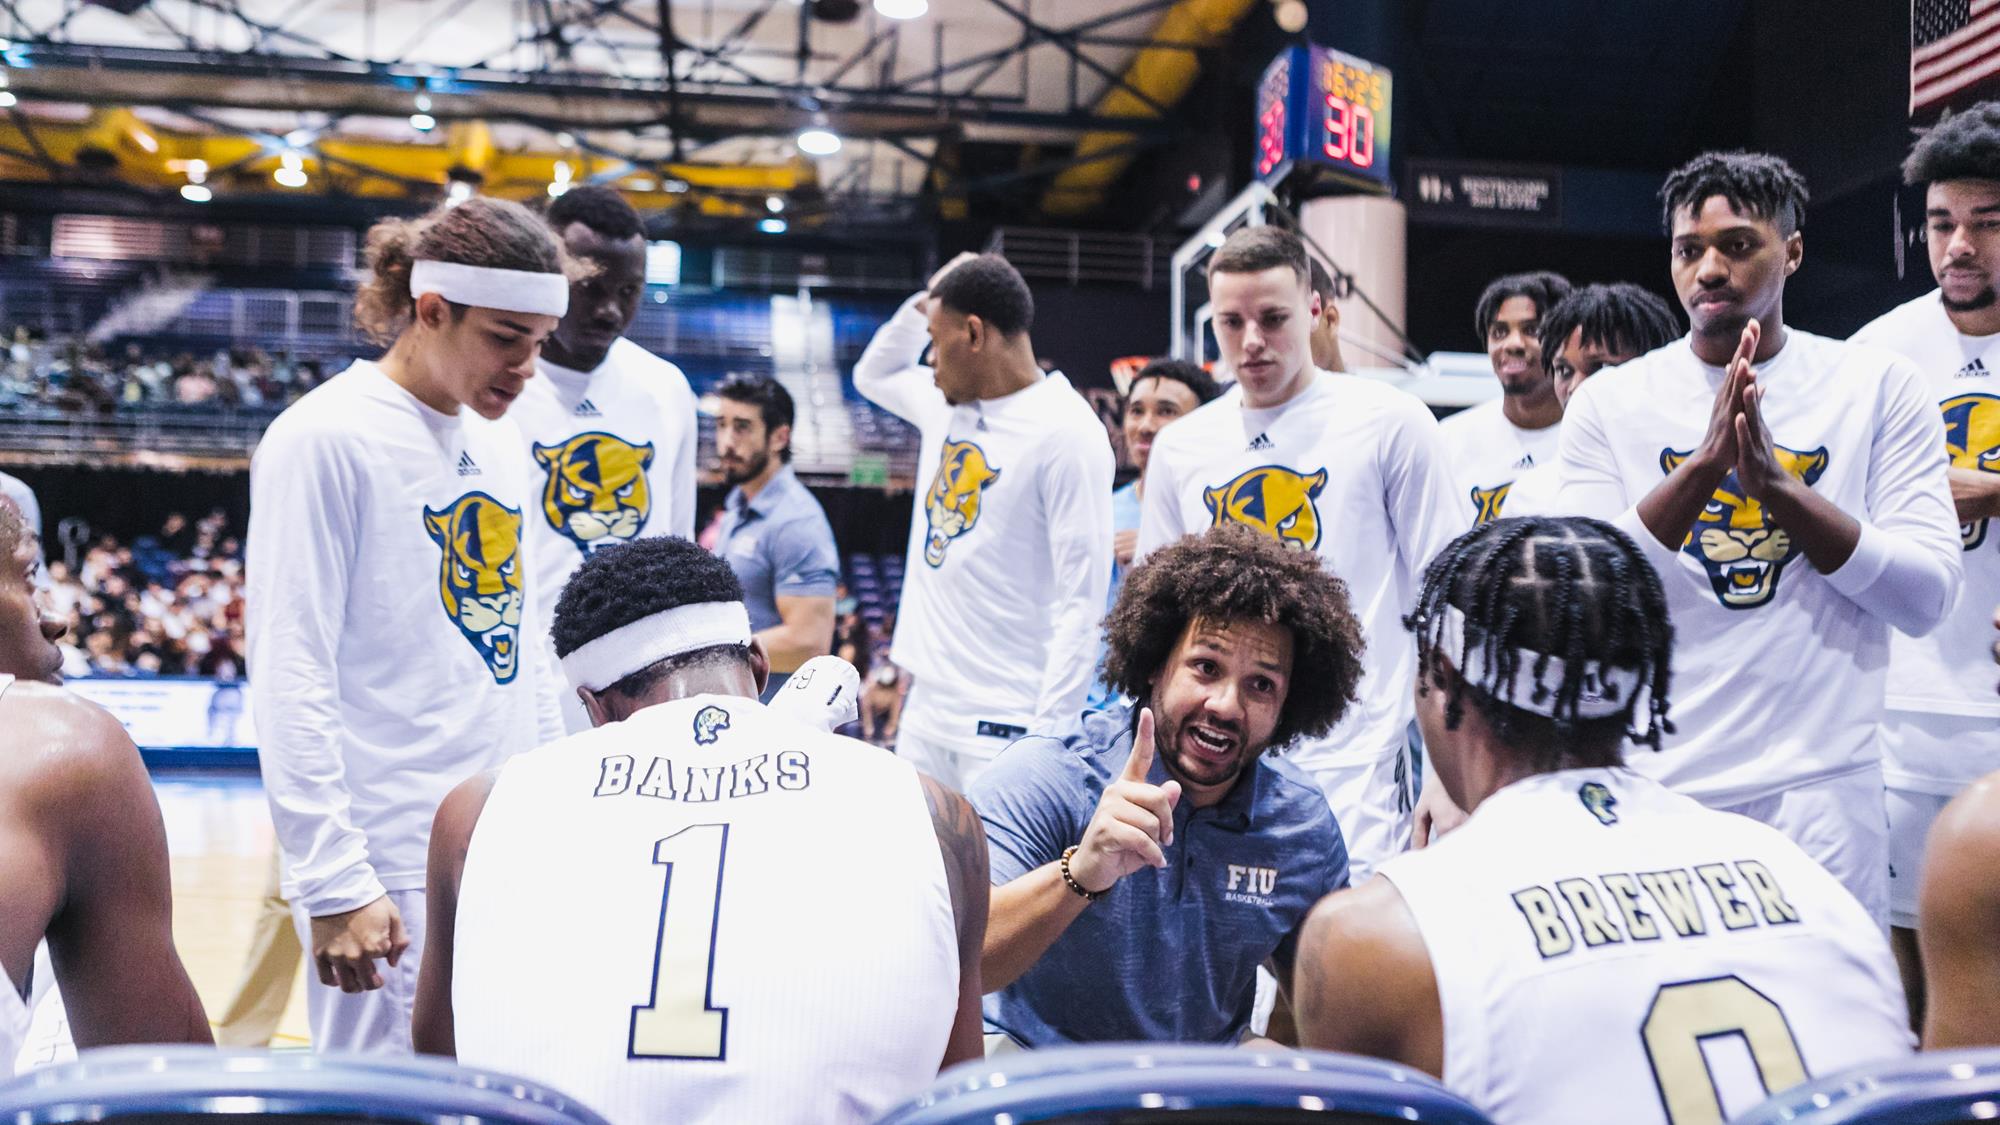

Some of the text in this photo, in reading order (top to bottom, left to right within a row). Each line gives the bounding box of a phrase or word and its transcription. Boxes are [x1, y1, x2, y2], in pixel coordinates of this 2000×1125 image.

[1324, 93, 1375, 169] 30
[593, 751, 810, 802] BANKS
[1225, 892, 1274, 907] BASKETBALL
[1227, 864, 1278, 895] FIU
[1511, 860, 1801, 959] BREWER
[627, 823, 730, 1061] 1
